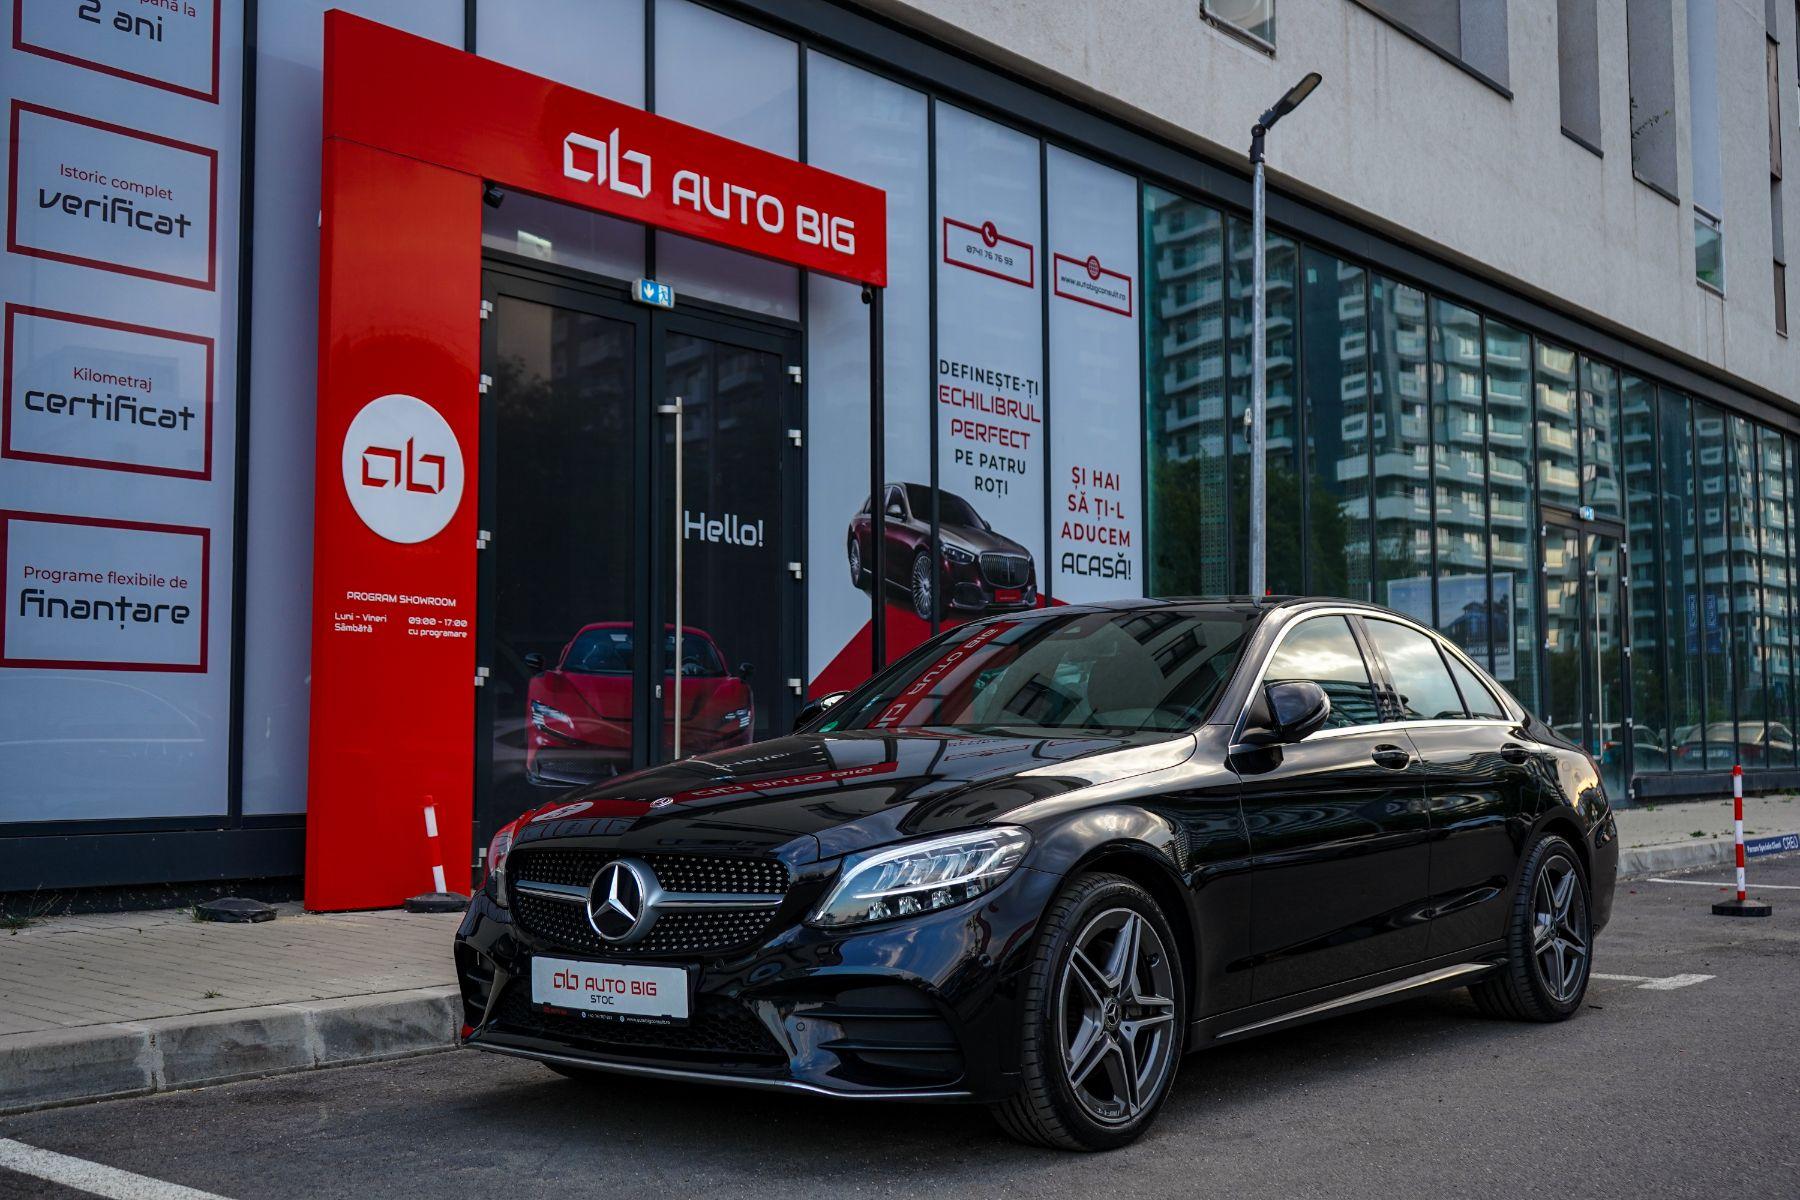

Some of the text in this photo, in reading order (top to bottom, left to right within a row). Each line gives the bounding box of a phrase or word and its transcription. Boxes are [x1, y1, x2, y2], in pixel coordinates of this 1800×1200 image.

[79, 0, 162, 42] 2 ani
[183, 2, 196, 17] la
[60, 163, 173, 200] Istoric complet
[39, 188, 191, 238] verificat
[672, 170, 784, 234] AUTO
[796, 205, 855, 255] BIG
[984, 250, 993, 260] 76
[994, 254, 1003, 263] 76
[1004, 257, 1013, 266] 93
[74, 367, 152, 392] Kilometraj
[939, 359, 1038, 399] DEFINEȘTE-ȚI
[25, 390, 195, 431] certificat
[939, 385, 1041, 423] ECHILIBRUL
[951, 419, 1030, 450] PERFECT
[955, 449, 1026, 474] PE PATRU
[975, 476, 1008, 498] ROȚI
[1071, 466, 1120, 491] ȘI HAI
[1068, 492, 1125, 521] SĂ ȚI-L
[684, 510, 763, 547] Hello!
[1061, 522, 1130, 547] ADUCEM
[24, 565, 188, 588] Programe flexibile de
[1061, 552, 1131, 580] ACASĂ!
[20, 588, 190, 629] finanțare
[347, 591, 456, 607] PROGRAM SHOWROOM
[334, 612, 354, 621] Luni
[362, 613, 387, 623] Vineri
[334, 622, 373, 633] Sâmbătă
[408, 616, 436, 626] 09:00
[444, 618, 468, 628] 17:00
[408, 628, 467, 638] cu programare
[585, 977, 626, 994] AUTO
[631, 981, 657, 996] BIG
[590, 995, 614, 1005] STOC
